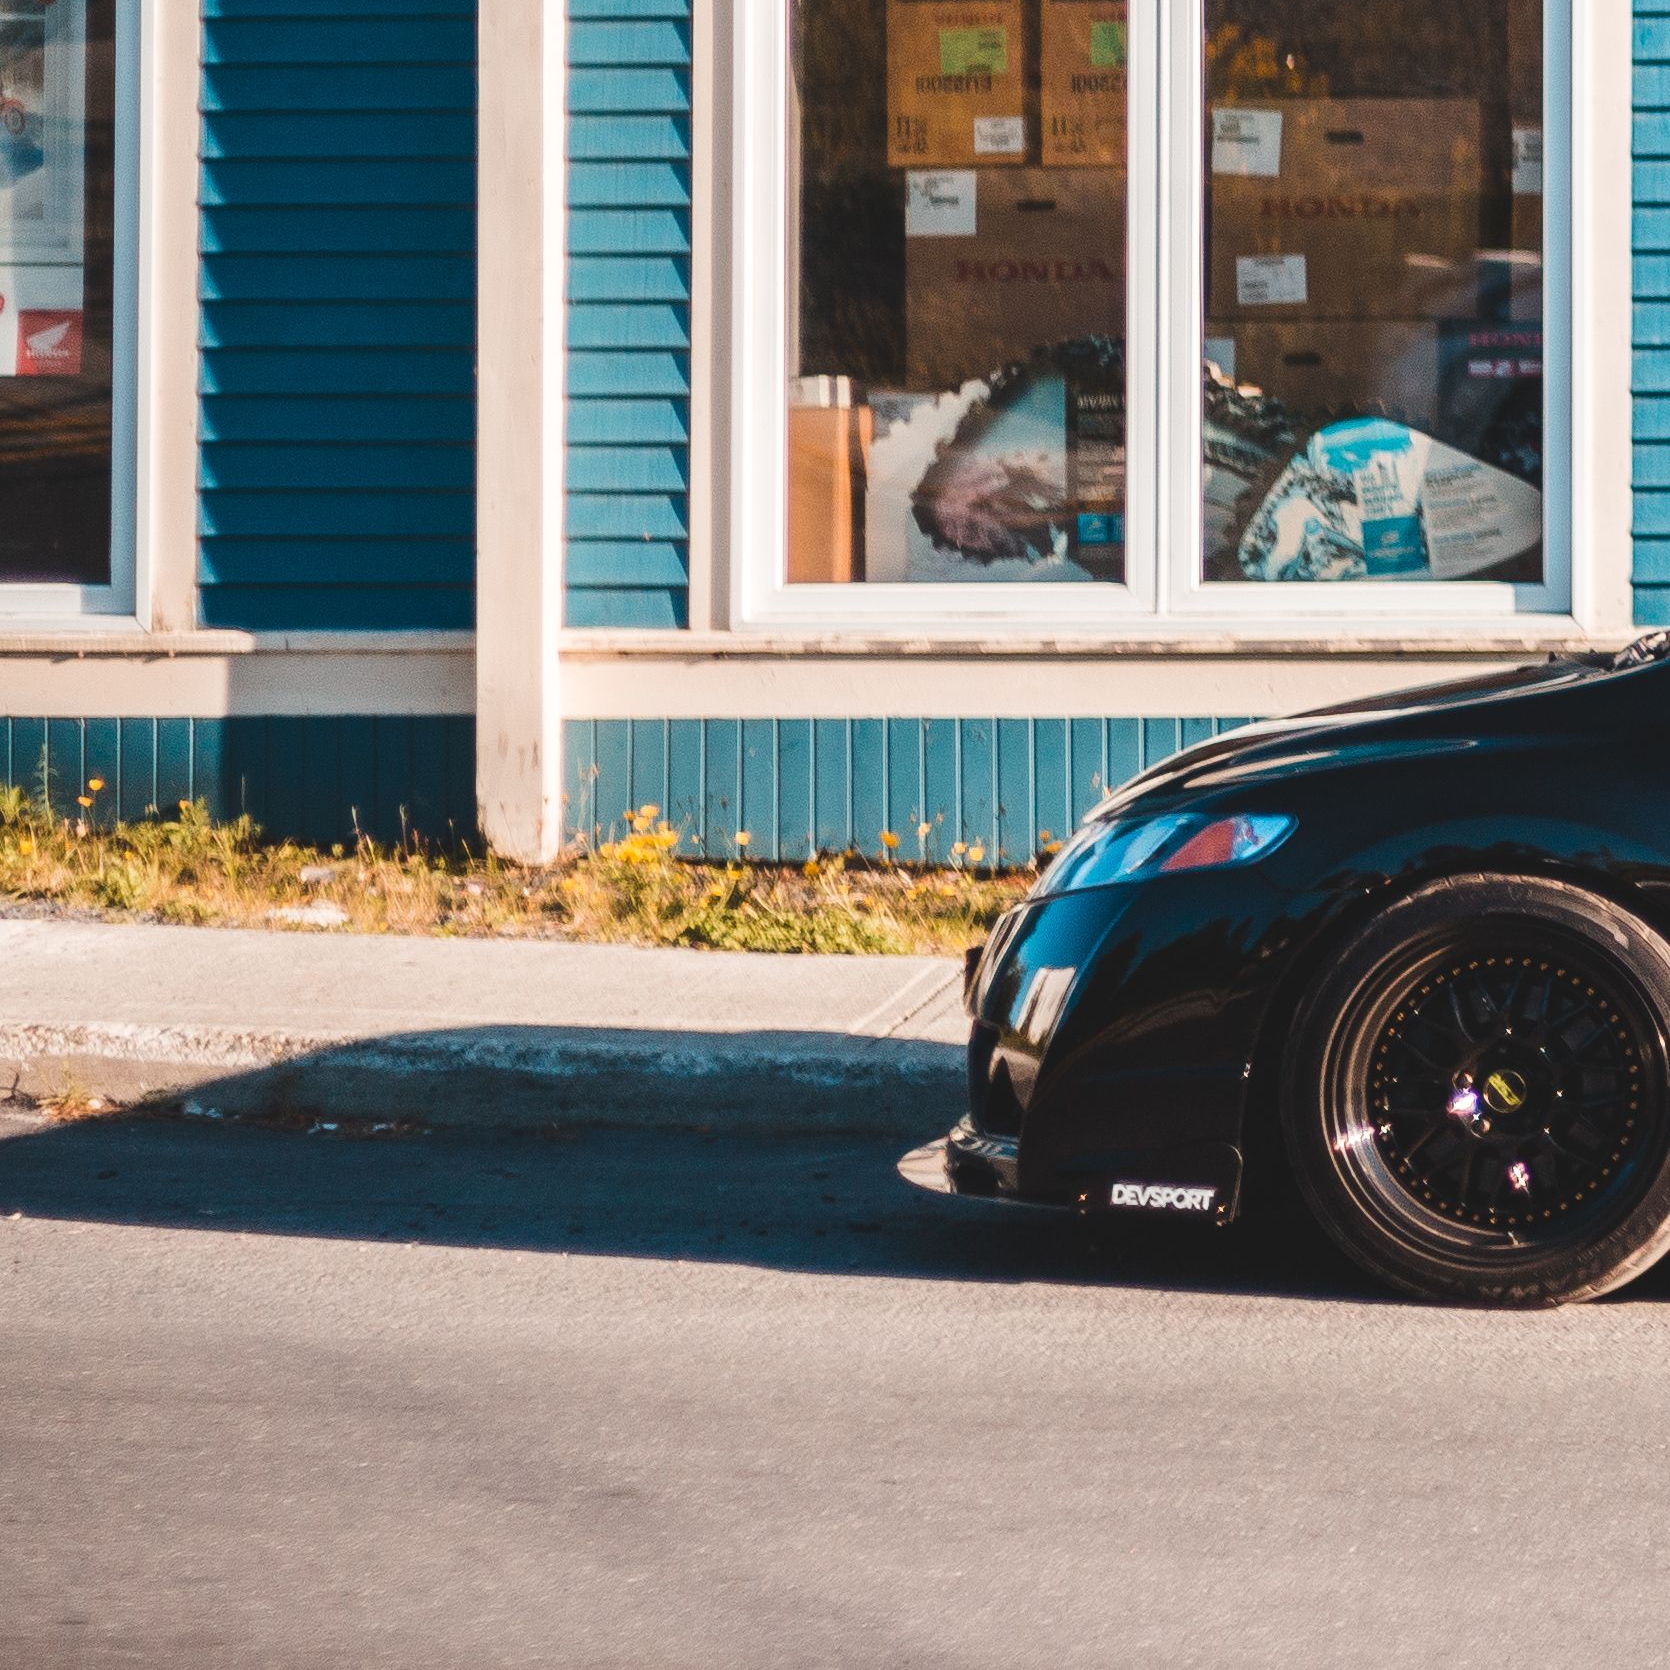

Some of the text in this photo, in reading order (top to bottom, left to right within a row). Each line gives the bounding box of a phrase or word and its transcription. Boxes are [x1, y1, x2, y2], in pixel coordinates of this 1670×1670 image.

[1260, 197, 1421, 220] HONDA
[955, 259, 1114, 283] HONDA
[1110, 1182, 1216, 1211] DEVSPORT
